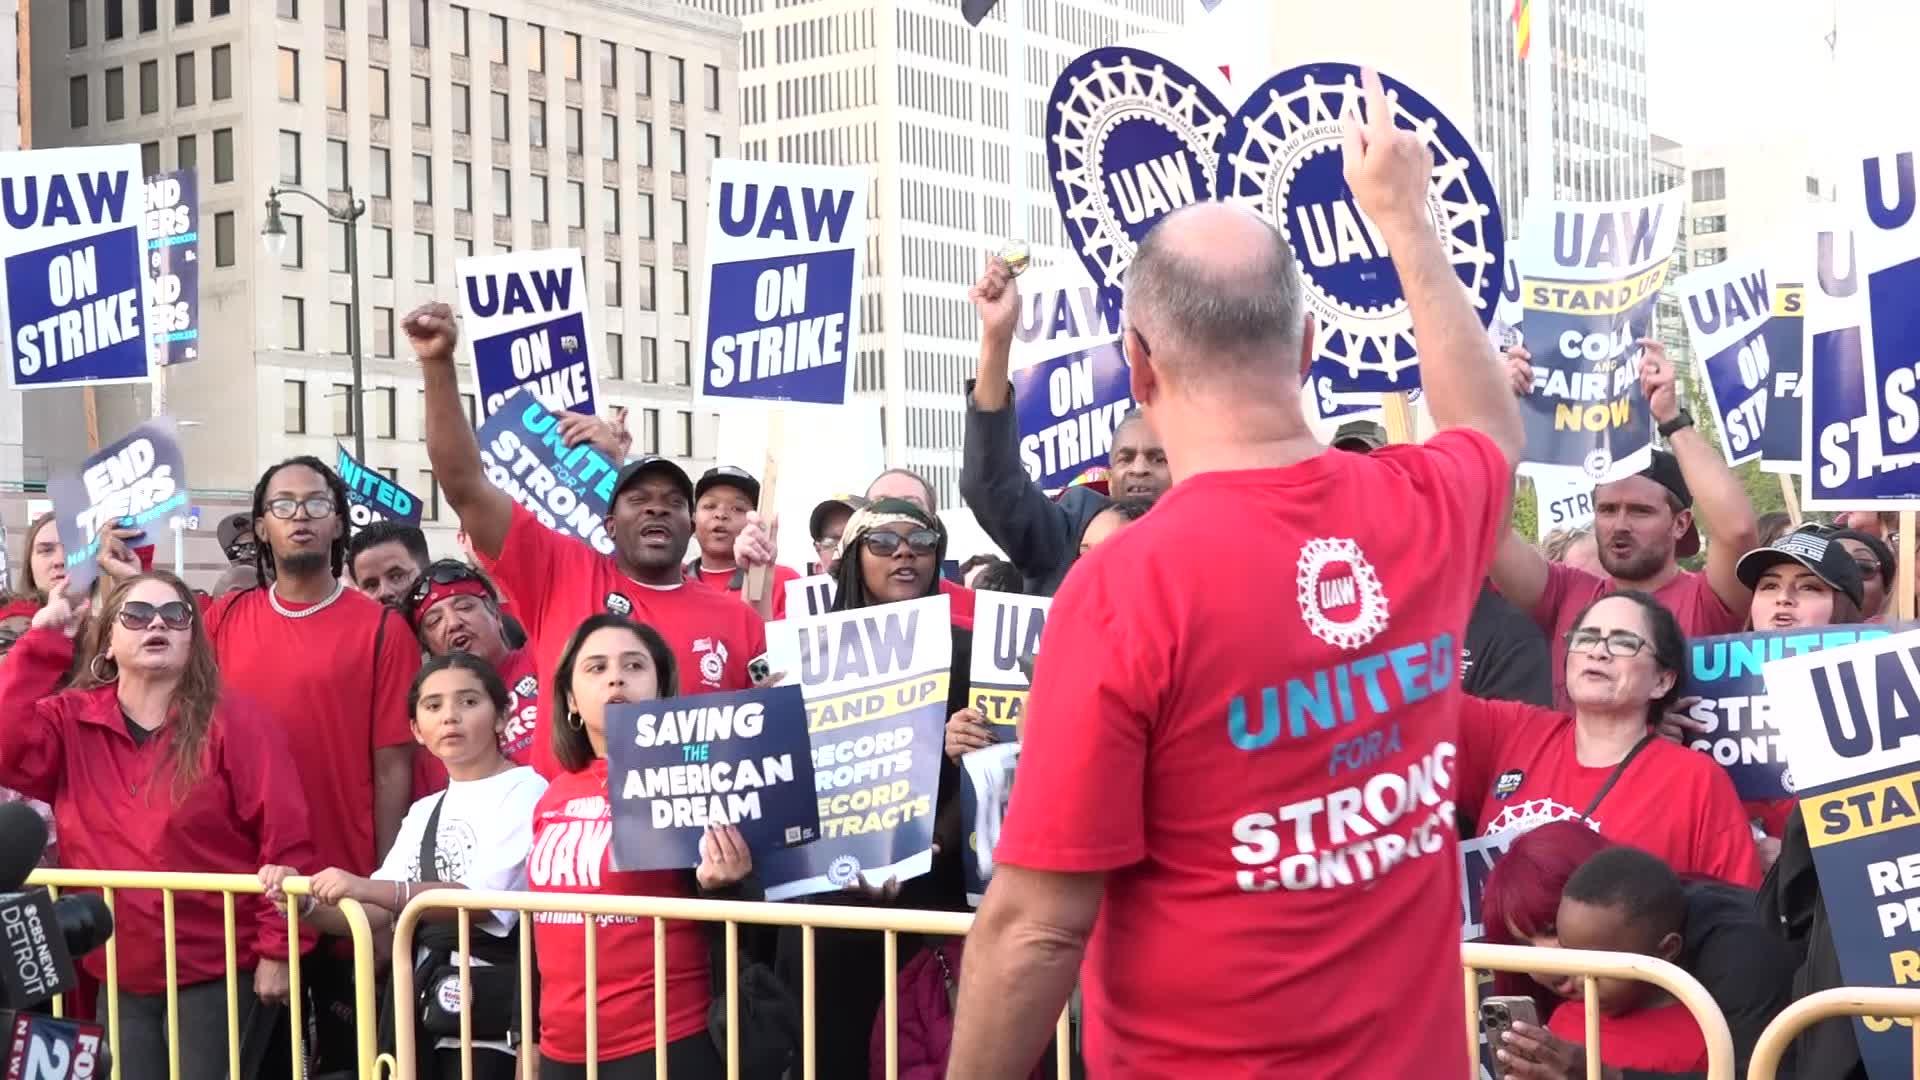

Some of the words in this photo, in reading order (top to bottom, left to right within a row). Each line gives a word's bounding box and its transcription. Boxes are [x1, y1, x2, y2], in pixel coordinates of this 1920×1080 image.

[1, 170, 129, 230] UAW
[719, 181, 855, 244] UAW
[1108, 149, 1196, 225] UAW
[1554, 203, 1664, 268] UAW
[48, 245, 98, 307] ON
[466, 267, 573, 318] UAW
[754, 262, 808, 322] ON
[1532, 286, 1632, 310] STAND
[1636, 270, 1661, 297] UP
[1687, 268, 1770, 335] UAW
[16, 288, 140, 376] STRIKE
[510, 328, 553, 381] ON
[709, 312, 845, 389] STRIKE
[1558, 320, 1633, 362] COLA
[1049, 357, 1095, 418] ON
[1531, 366, 1606, 401] FAIR
[1737, 333, 1771, 390] ON
[1554, 395, 1631, 432] NOW
[83, 438, 156, 506] END
[490, 429, 616, 555] STRONG
[550, 462, 578, 488] FOR
[76, 464, 176, 544] TIERS
[1319, 575, 1357, 611] UAW
[798, 608, 920, 686] UAW
[896, 679, 938, 706] UP
[1227, 632, 1455, 752] UNITED
[634, 702, 765, 748] SAVING
[682, 743, 709, 763] THE
[1328, 729, 1384, 778] FOR
[622, 753, 794, 800] AMERICAN
[1231, 741, 1457, 866] STRONG
[651, 791, 763, 830] DREAM
[530, 820, 613, 887] UAW
[1, 904, 46, 995] DETROIT
[27, 916, 46, 944] CBS
[36, 941, 59, 988] NEWS
[8, 1020, 29, 1080] NEW
[24, 1033, 71, 1080] 2
[71, 1033, 100, 1080] FO
